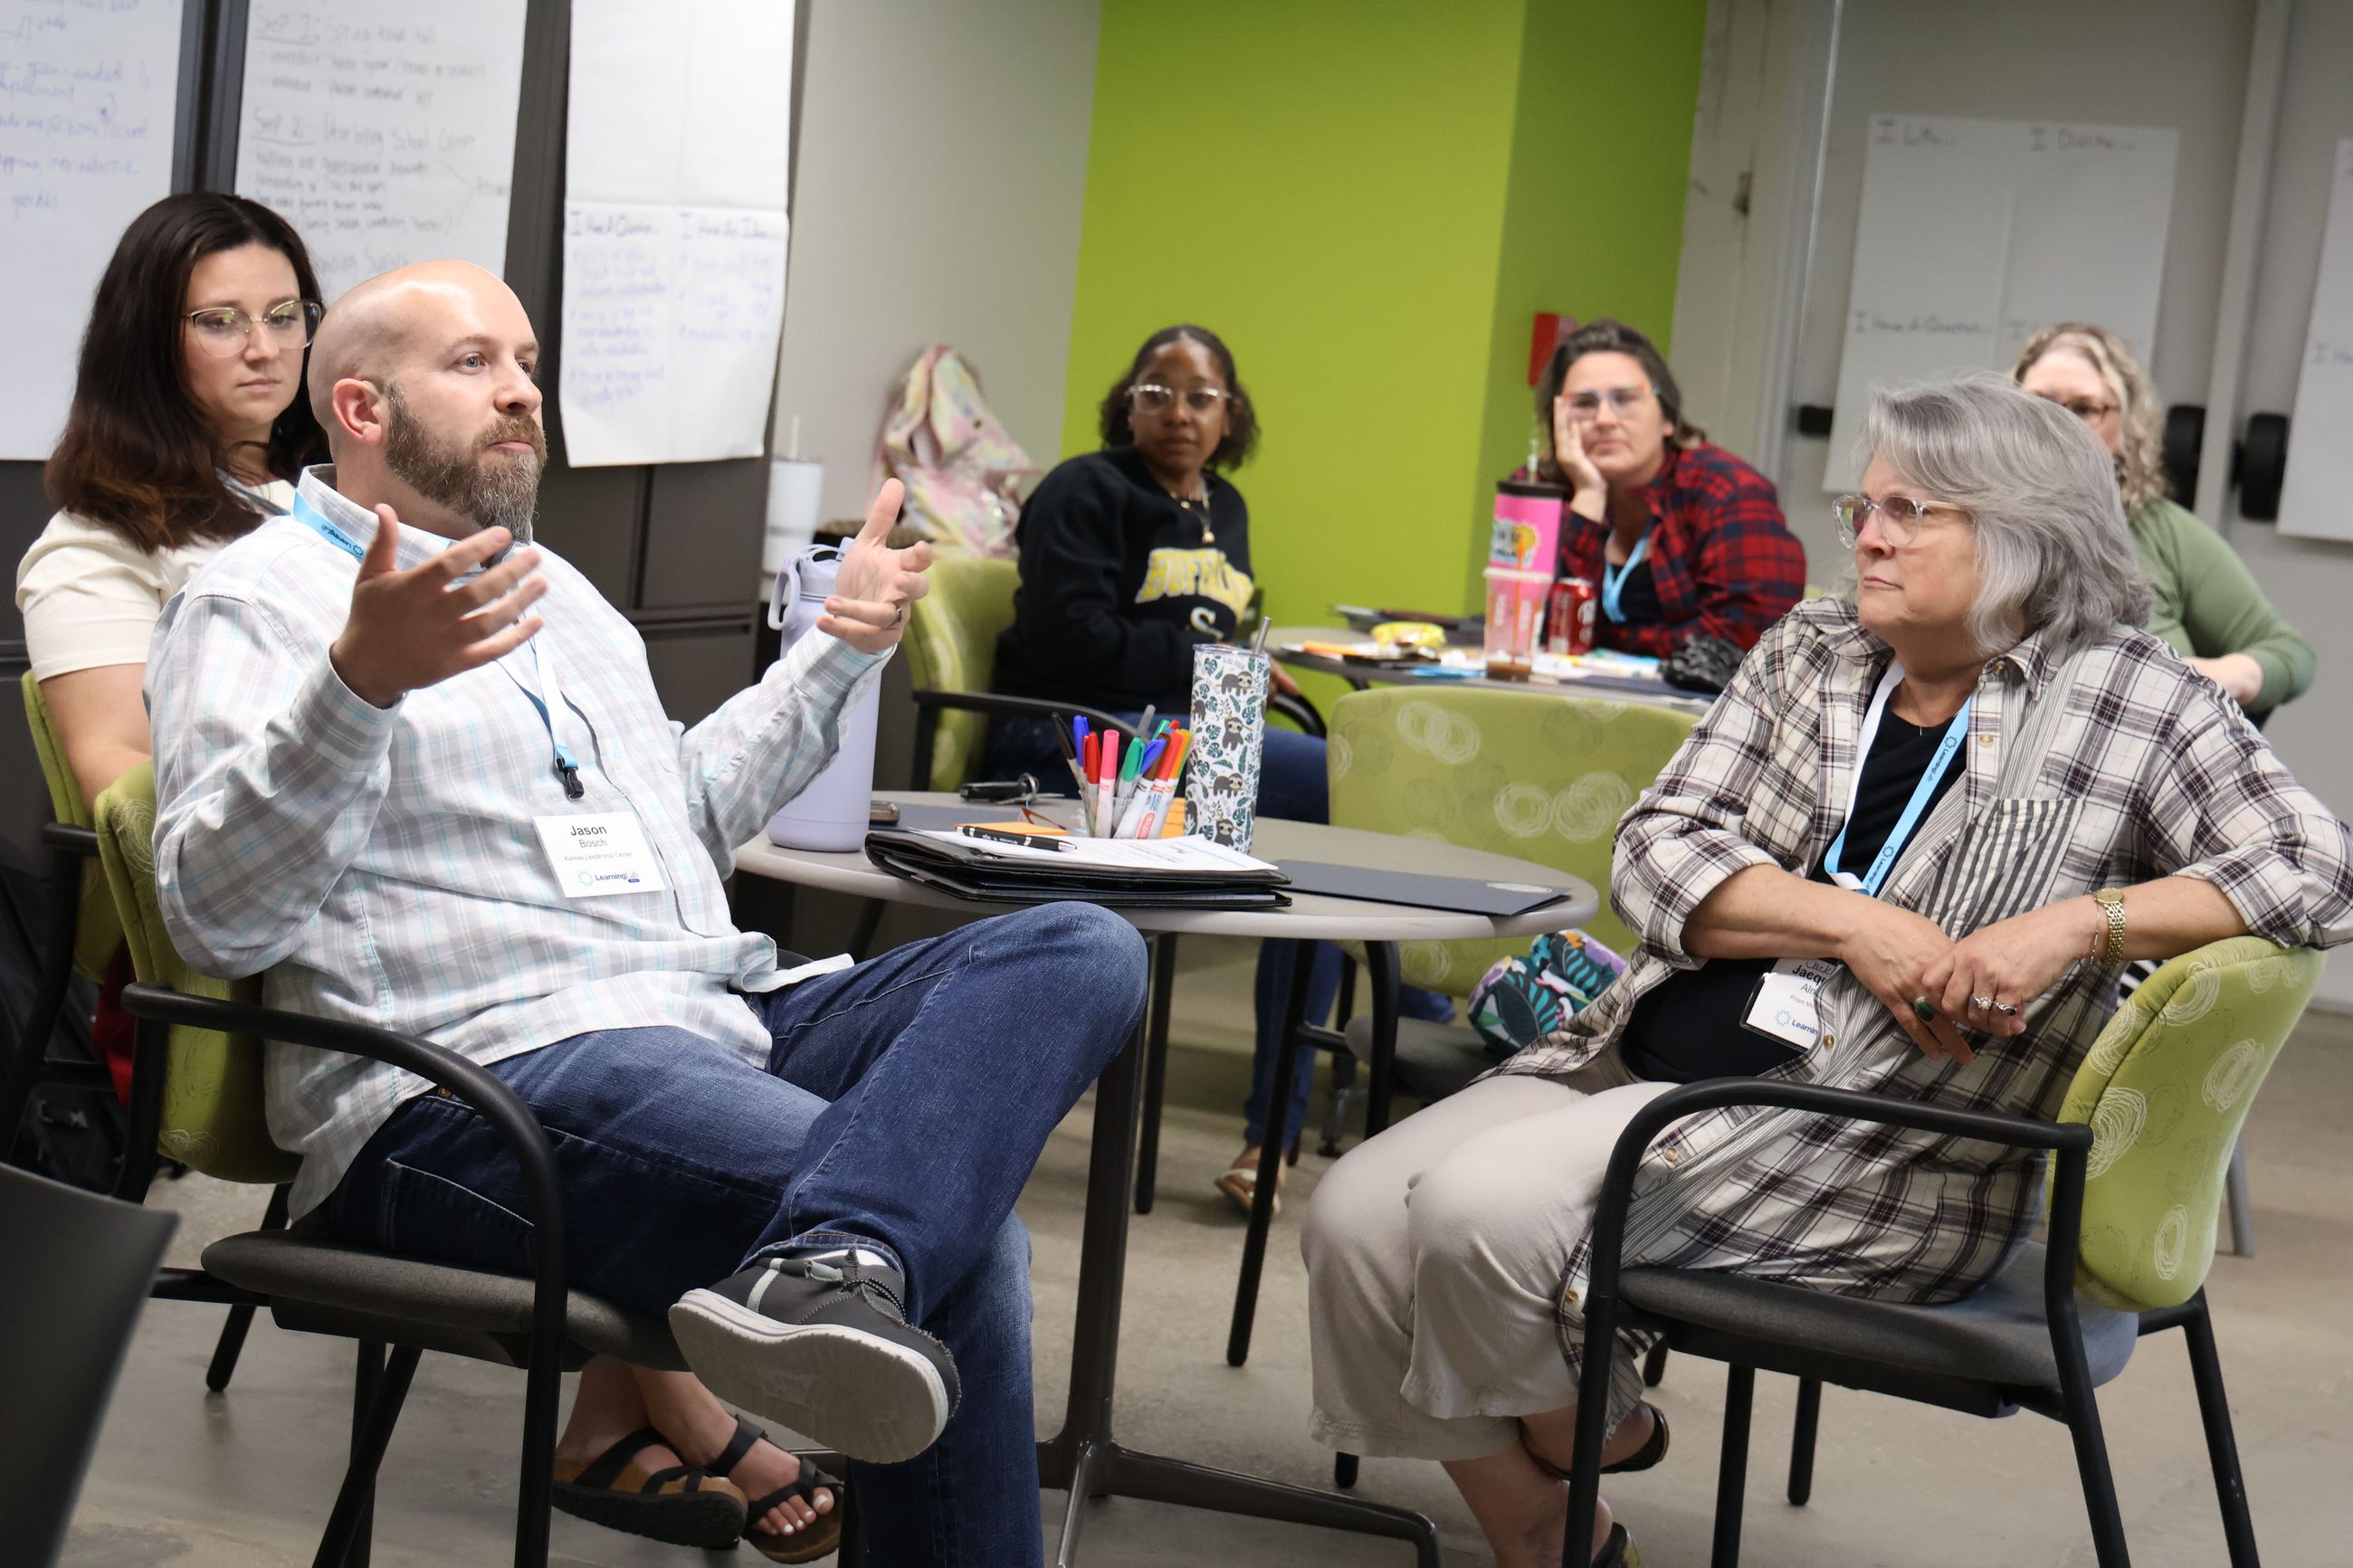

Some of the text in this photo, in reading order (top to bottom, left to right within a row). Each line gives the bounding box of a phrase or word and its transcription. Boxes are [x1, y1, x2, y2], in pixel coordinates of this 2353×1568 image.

[570, 825, 607, 836] Jason
[578, 839, 607, 848] Bosch
[564, 851, 633, 861] Kansas Leadership Center
[1791, 1019, 1819, 1037] Learnin
